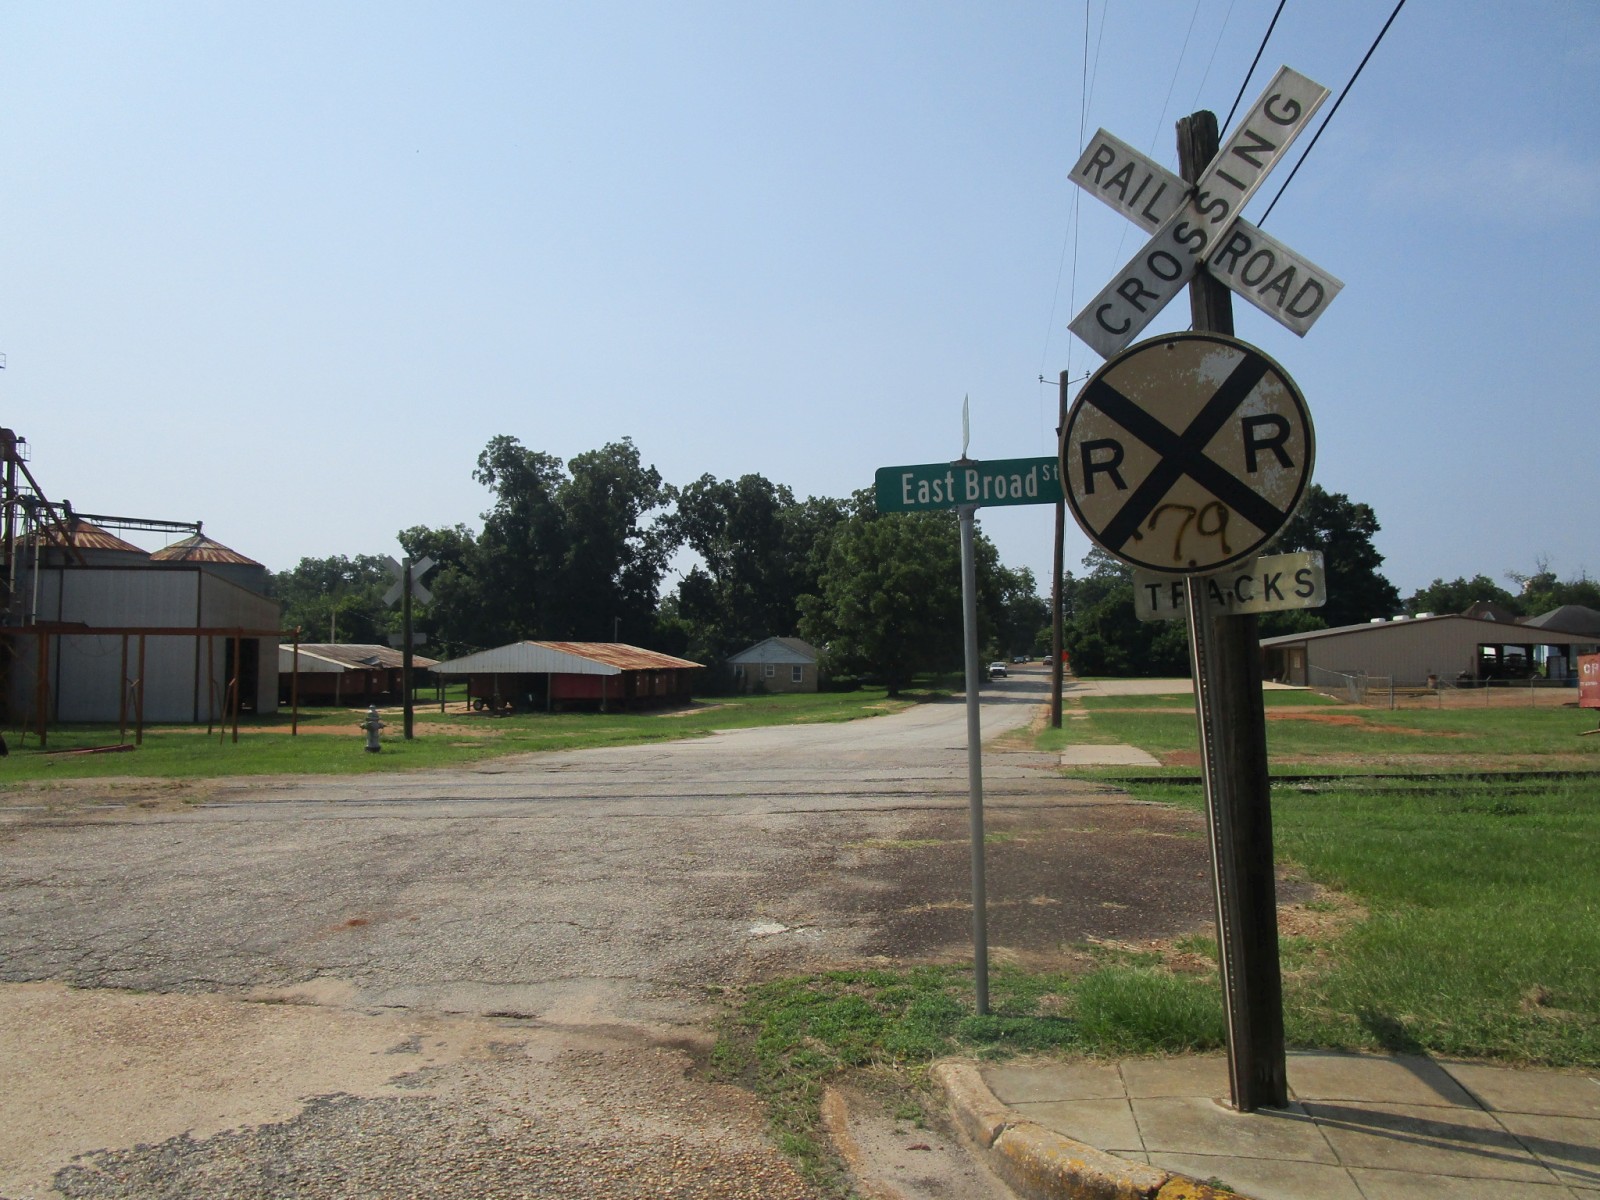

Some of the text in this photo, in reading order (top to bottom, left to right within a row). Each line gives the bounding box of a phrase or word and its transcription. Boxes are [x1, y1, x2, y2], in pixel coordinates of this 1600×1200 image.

[1081, 143, 1325, 319] RAIL ROAD
[1095, 93, 1302, 335] CROSSING
[902, 464, 1059, 504] East Broad St
[1080, 413, 1295, 494] R R
